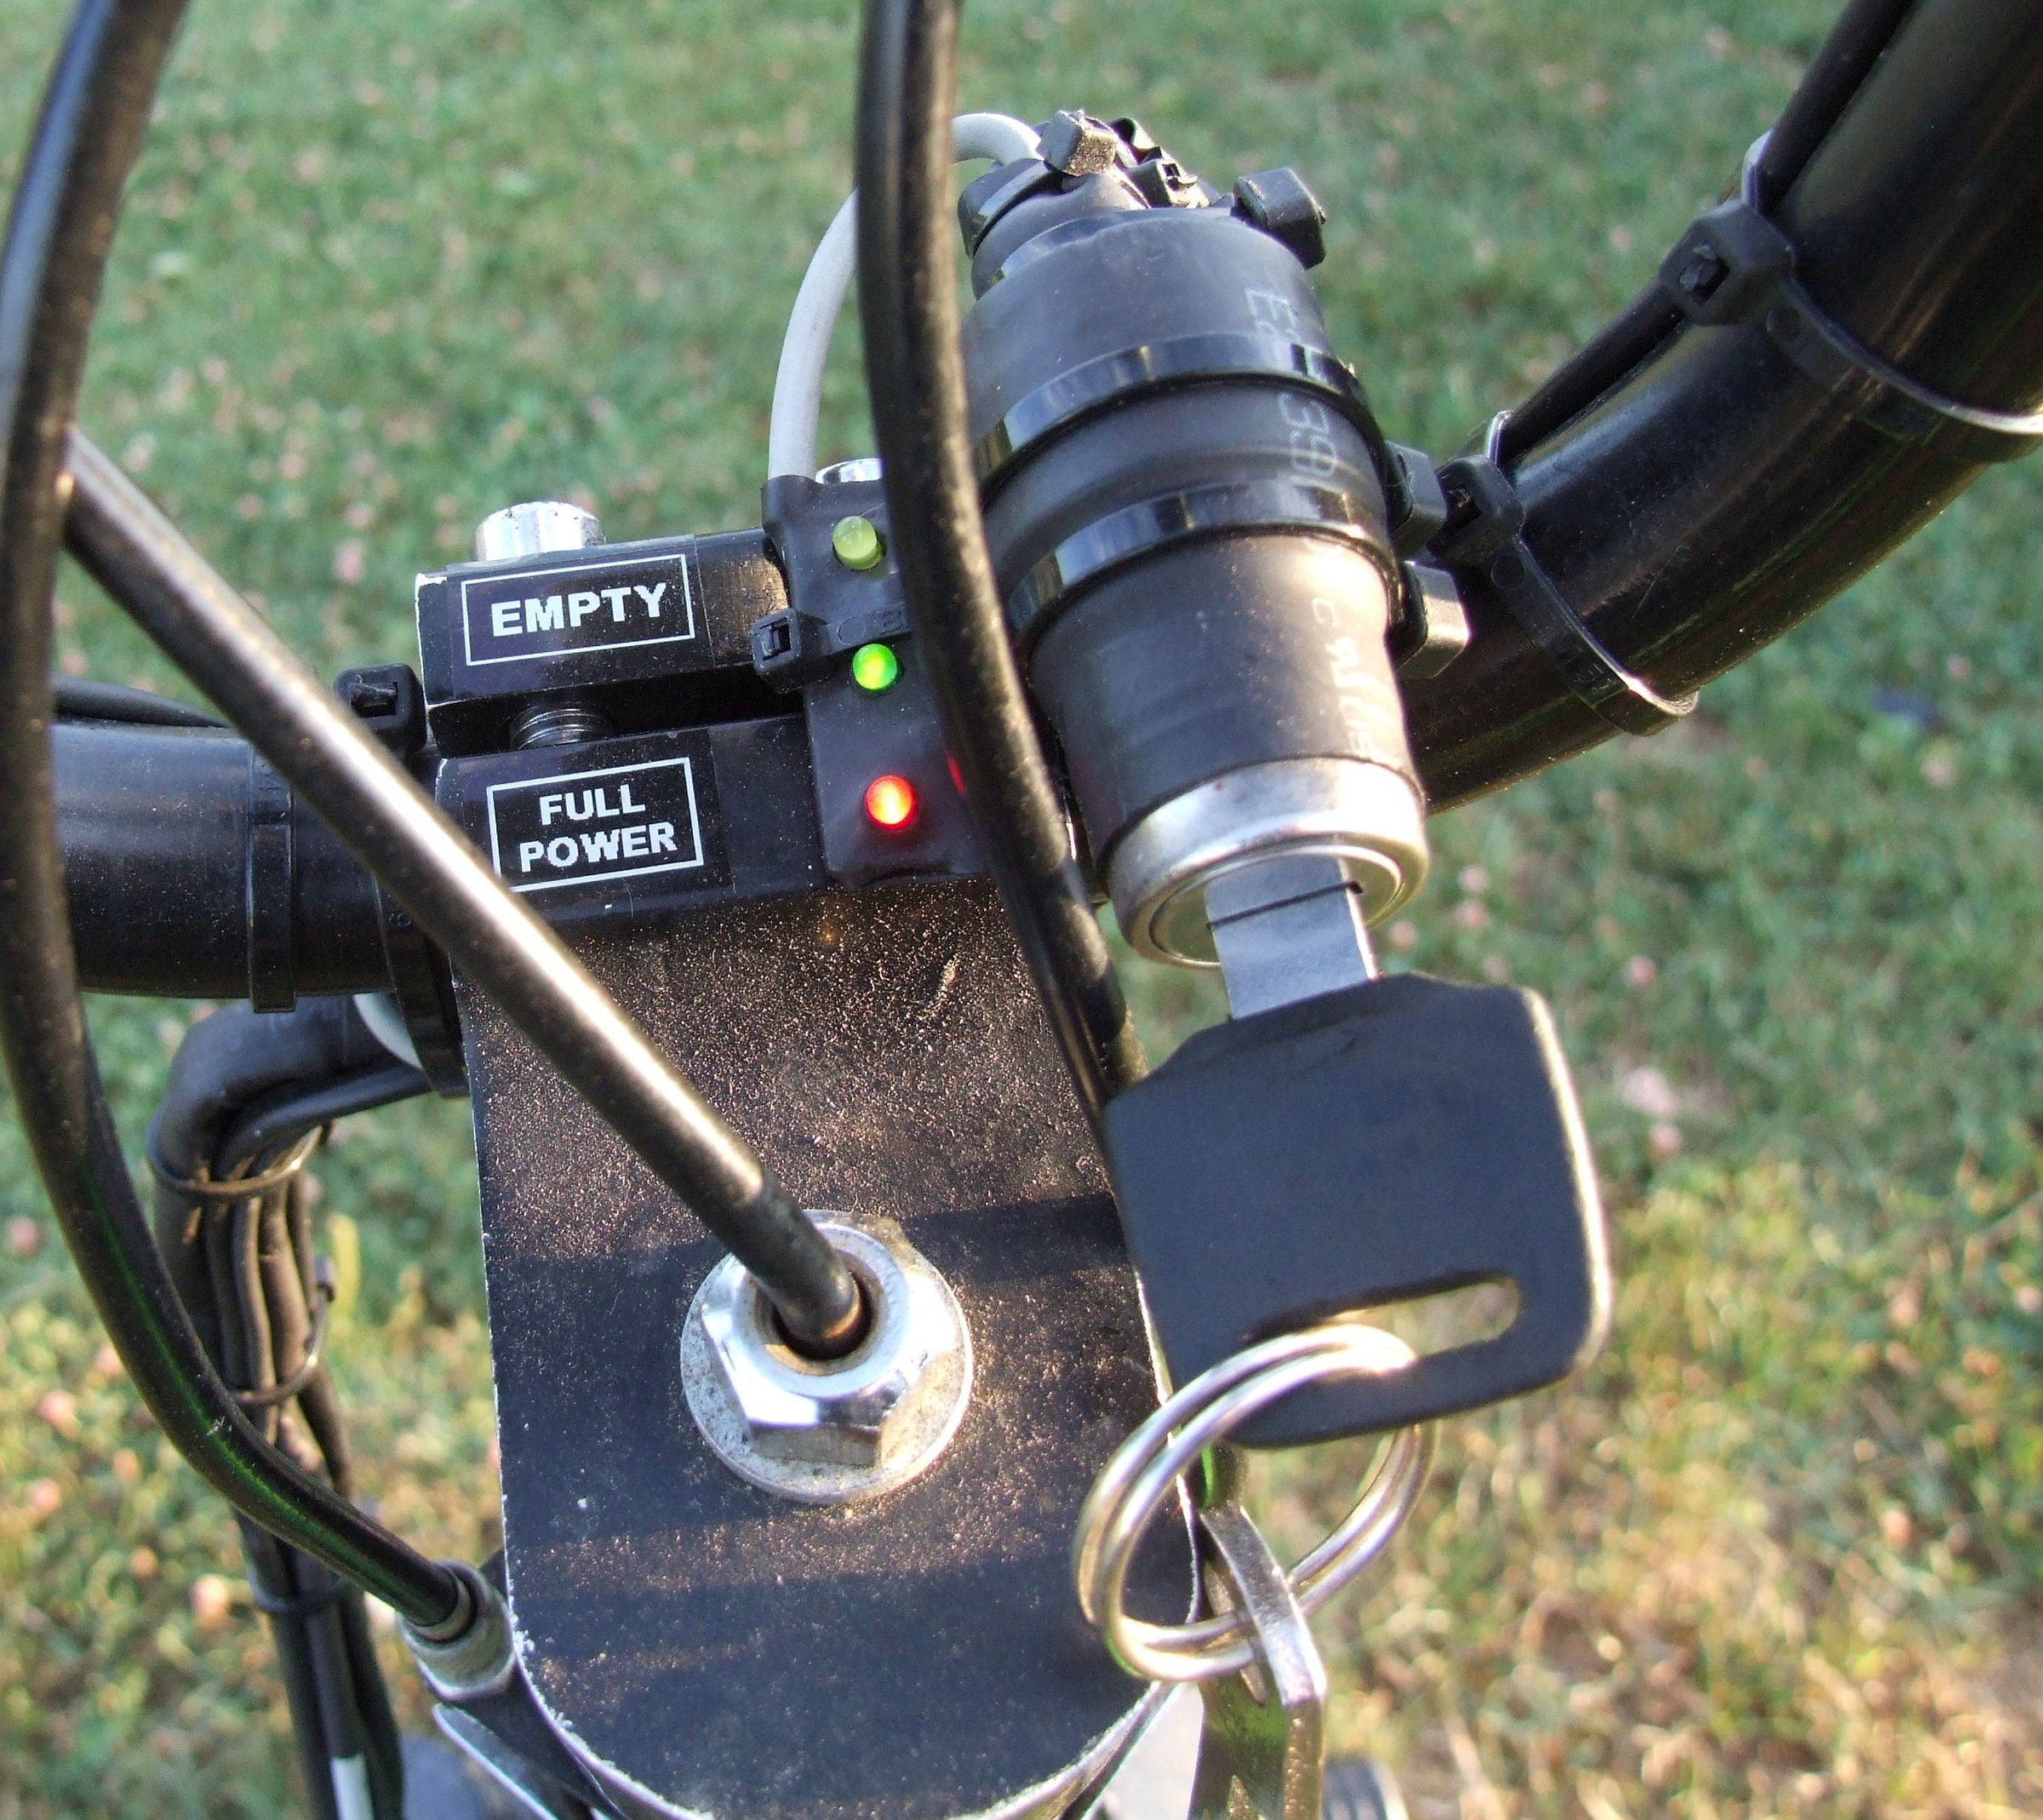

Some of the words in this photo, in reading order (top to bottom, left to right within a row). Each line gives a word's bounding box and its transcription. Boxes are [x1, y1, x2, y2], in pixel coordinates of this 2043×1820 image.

[490, 581, 667, 637] EMPTY
[539, 783, 647, 826] FULL
[518, 821, 678, 873] POWER
